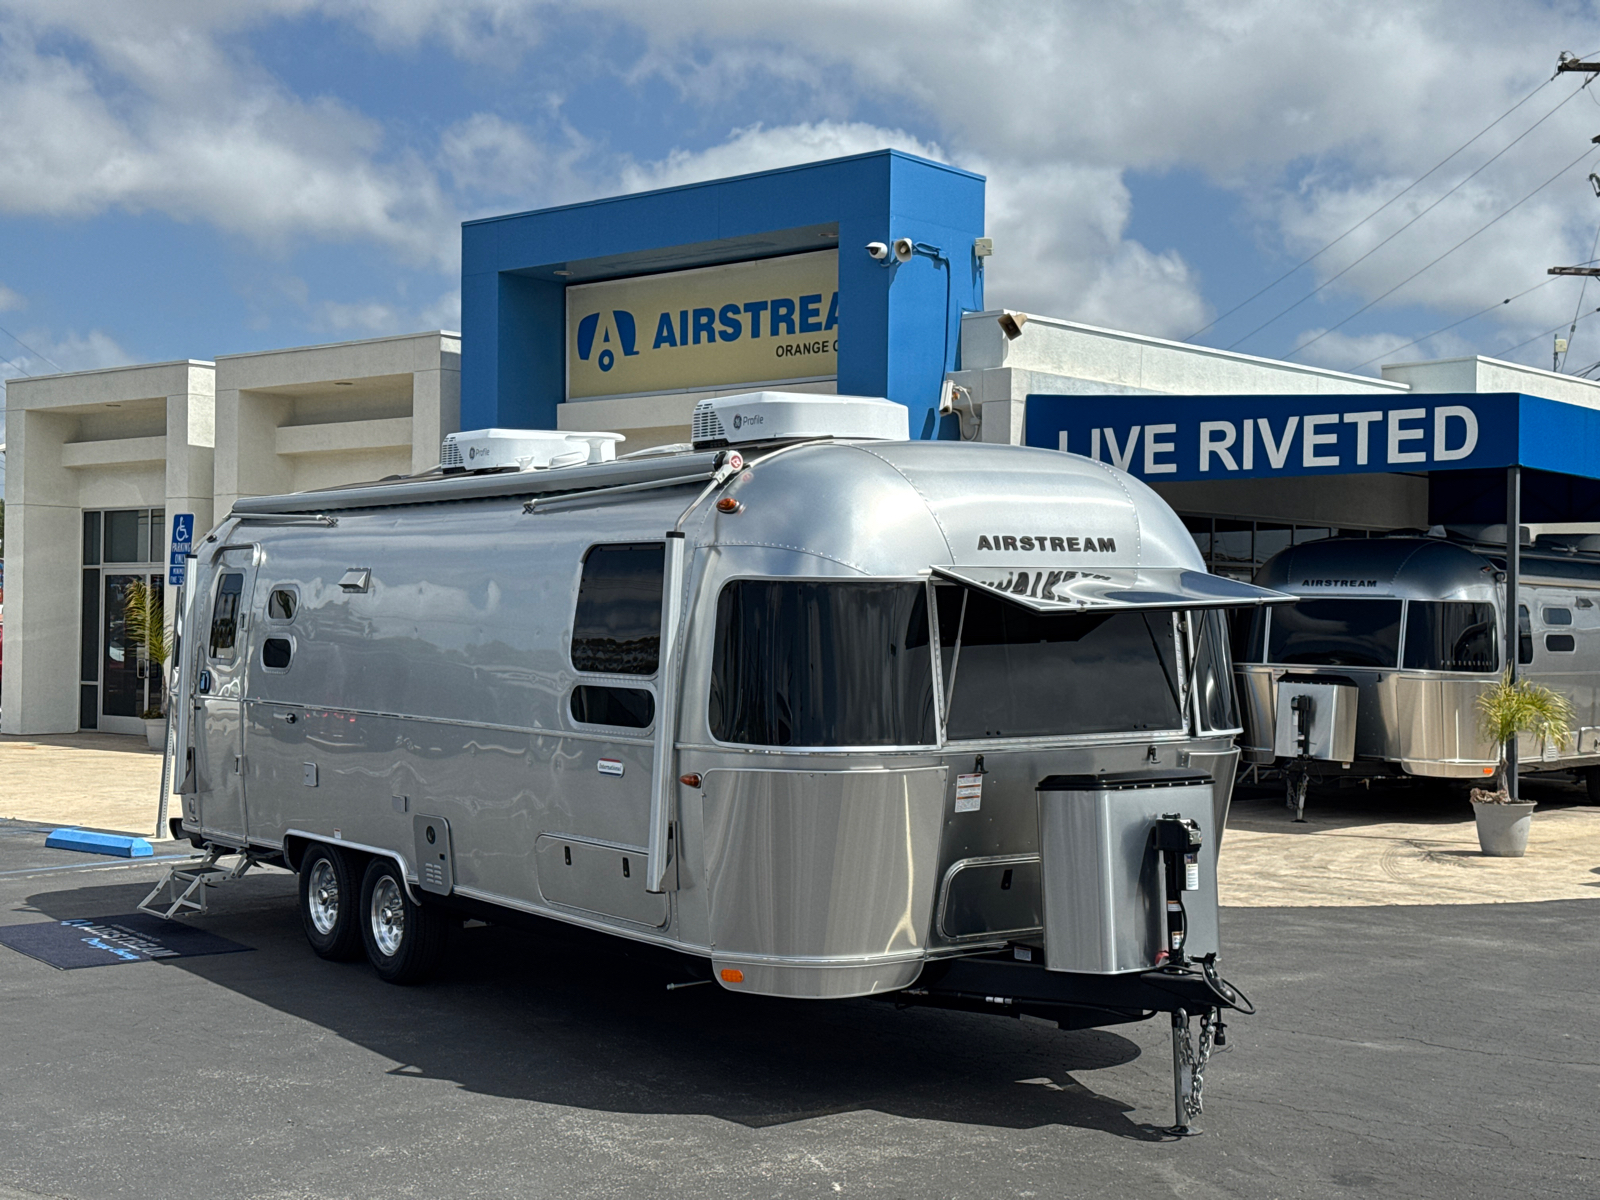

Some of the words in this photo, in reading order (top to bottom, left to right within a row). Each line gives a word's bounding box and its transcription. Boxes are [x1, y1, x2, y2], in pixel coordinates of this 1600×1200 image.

[652, 291, 839, 349] AIRSTREA
[775, 340, 829, 358] ORANGE
[743, 415, 764, 426] Profile
[1199, 405, 1479, 472] RIVETED
[171, 542, 191, 552] PARKING
[978, 535, 1117, 552] AIRSTREAM
[1302, 579, 1377, 587] AIRSTREAM
